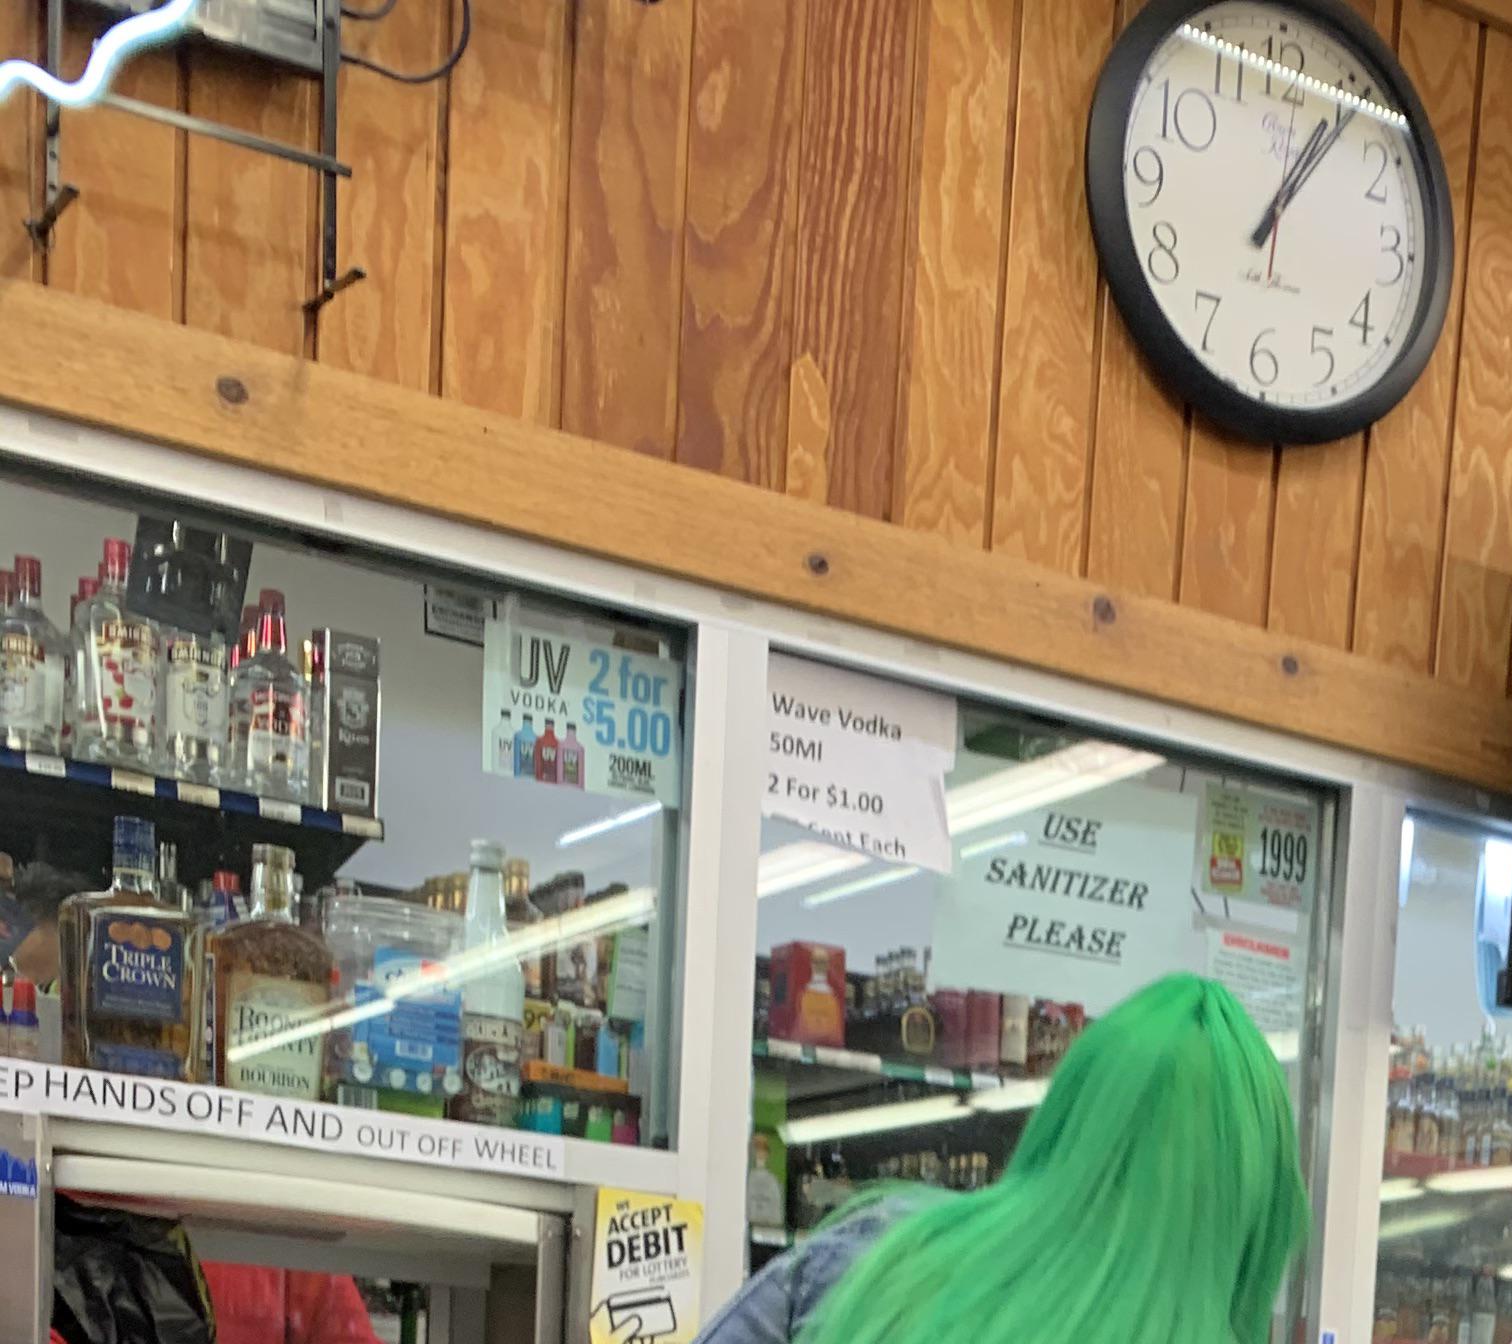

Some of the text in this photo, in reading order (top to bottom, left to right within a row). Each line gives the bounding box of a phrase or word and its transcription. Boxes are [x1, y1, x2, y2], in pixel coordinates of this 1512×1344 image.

[1212, 33, 1249, 104] 11
[1263, 34, 1305, 108] 12
[1160, 78, 1217, 152] 10
[1132, 145, 1164, 208] 9
[1362, 140, 1390, 205] 2
[1147, 220, 1180, 285] 8
[1375, 224, 1404, 287] 3
[1194, 289, 1222, 354] 7
[1348, 289, 1376, 347] 4
[1249, 328, 1280, 387] 6
[1310, 326, 1336, 386] 5
[513, 634, 670, 708] UV 2 for
[510, 689, 672, 758] VODKA $5.00
[771, 691, 902, 742] Wave Vodka
[607, 753, 656, 780] 200ML
[767, 772, 884, 815] 2 For $1.00
[1042, 813, 1102, 848] USE
[985, 858, 1149, 910] SANITIZER
[104, 942, 172, 972] TRIPLE
[1005, 914, 1126, 957] PLEASE
[102, 961, 176, 990] CROWN
[240, 1065, 311, 1090] BOURBON
[44, 1068, 177, 1117] HANDS
[186, 1089, 255, 1130] OFF
[265, 1102, 344, 1143] AND
[357, 1124, 411, 1153] OUT
[417, 1135, 466, 1162] OFF
[474, 1136, 559, 1172] WHEEL
[606, 1224, 688, 1270] DEBIT
[607, 1203, 673, 1236] ACCEPT
[619, 1255, 688, 1283] FOR LOTTERY
